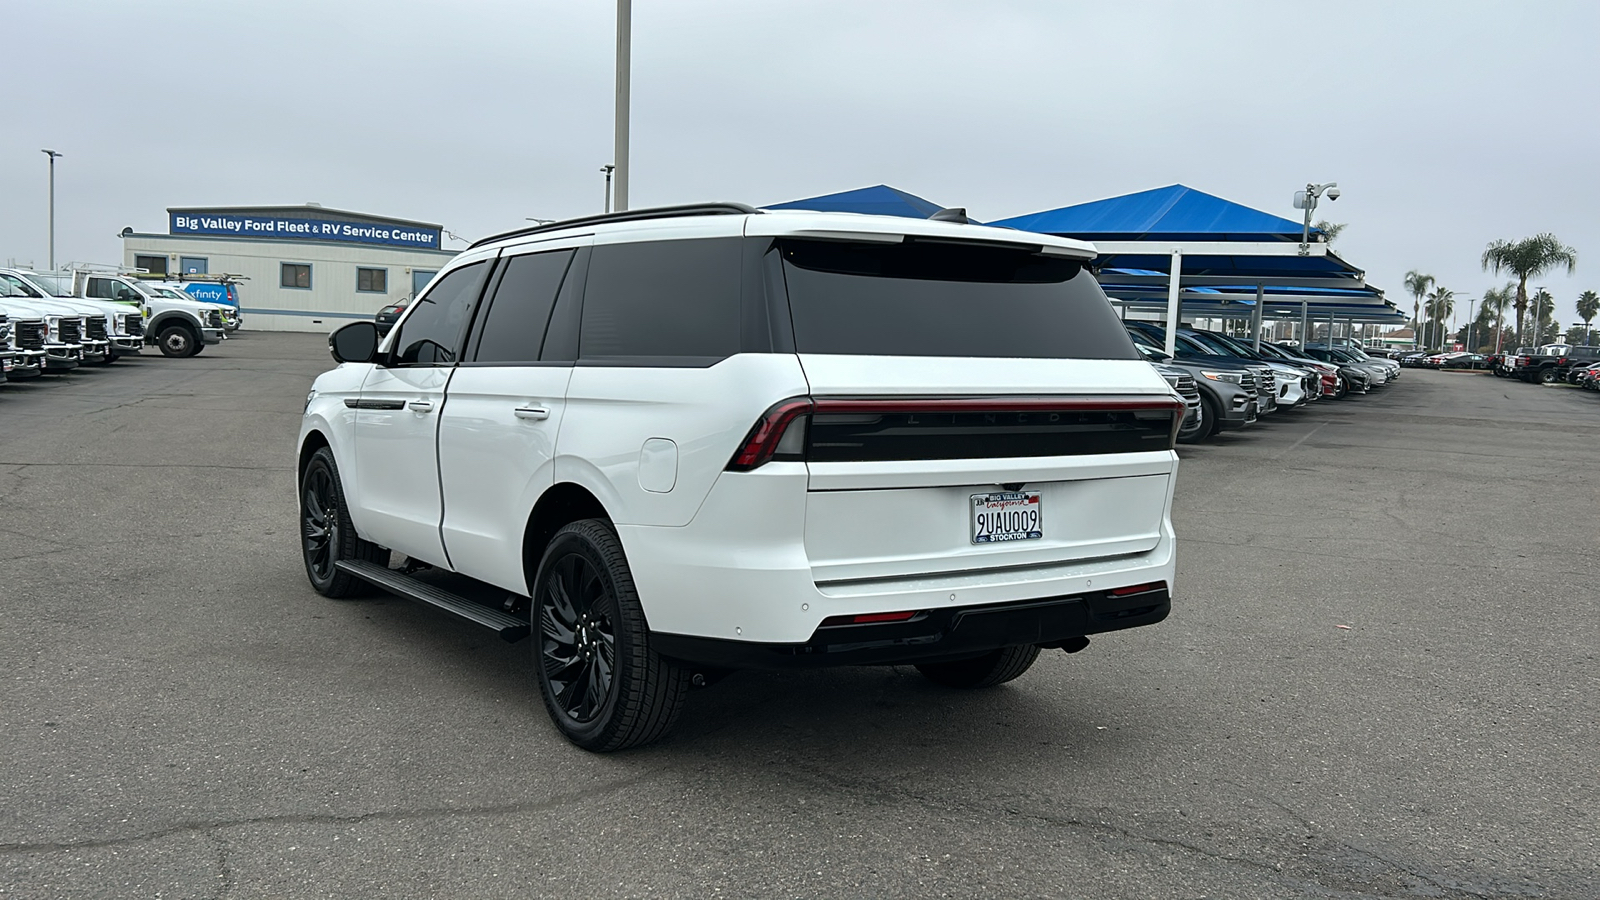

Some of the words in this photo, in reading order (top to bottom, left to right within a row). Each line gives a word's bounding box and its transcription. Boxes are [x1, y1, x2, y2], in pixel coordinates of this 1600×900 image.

[176, 217, 198, 230] Big
[201, 217, 242, 232] Valley
[244, 220, 275, 232] Ford
[277, 221, 310, 233] Fleet
[312, 225, 319, 234] &
[322, 223, 341, 235] RV
[342, 225, 390, 239] Service
[391, 229, 434, 243] Center
[190, 289, 222, 301] xfinity
[977, 510, 1038, 535] 9UAU009
[990, 532, 1027, 542] STOCKTON
